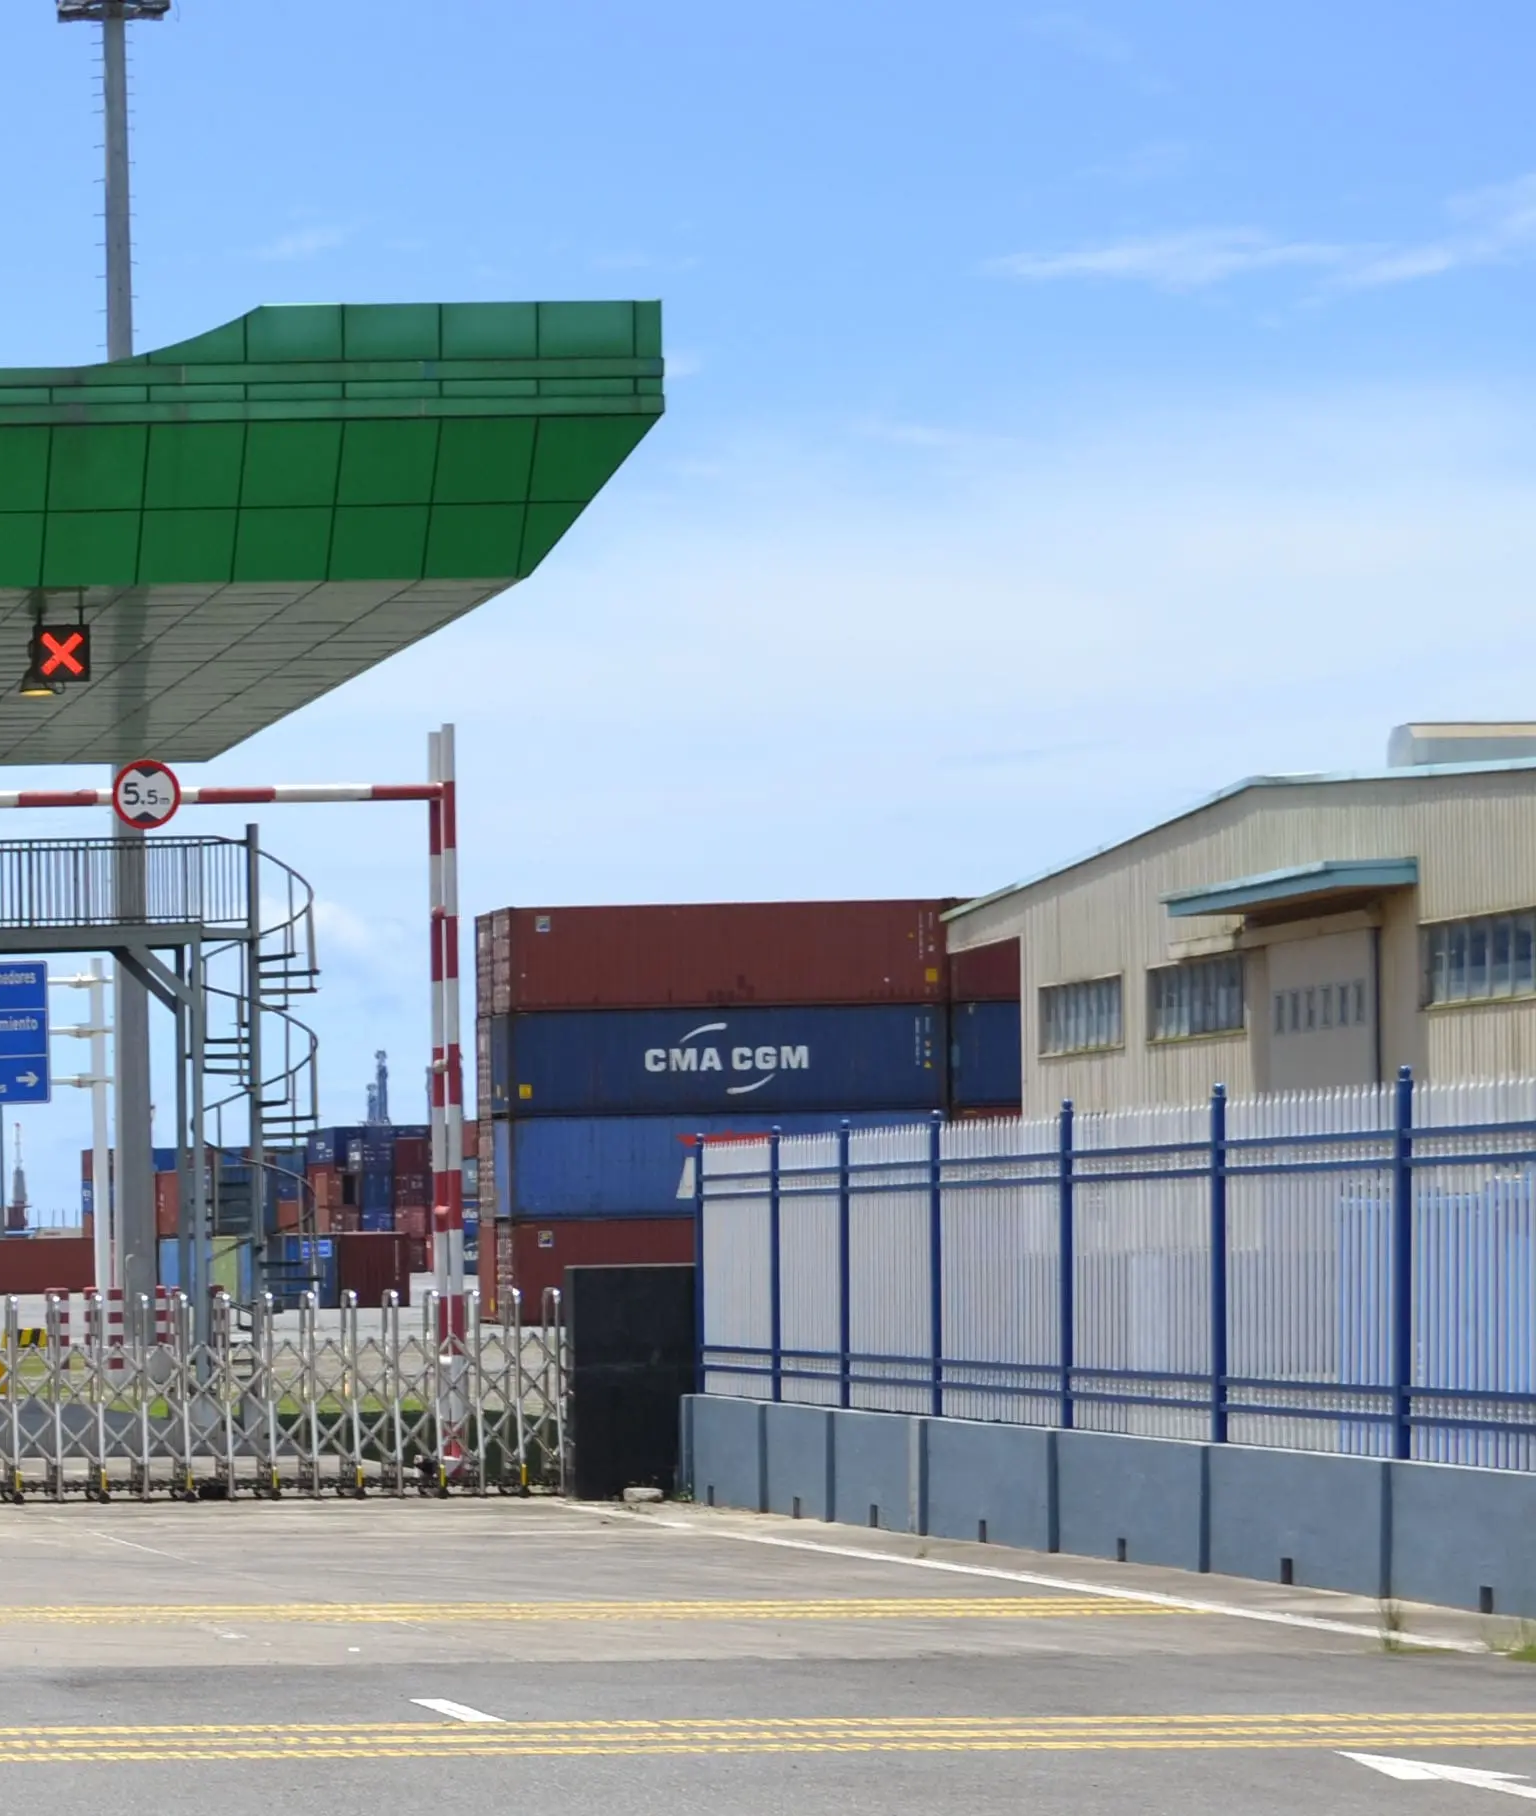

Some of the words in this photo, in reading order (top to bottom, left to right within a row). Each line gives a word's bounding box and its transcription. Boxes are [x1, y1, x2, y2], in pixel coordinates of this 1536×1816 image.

[123, 781, 170, 806] 5.5m
[644, 1047, 724, 1072] CMA
[731, 1045, 810, 1071] CGM
